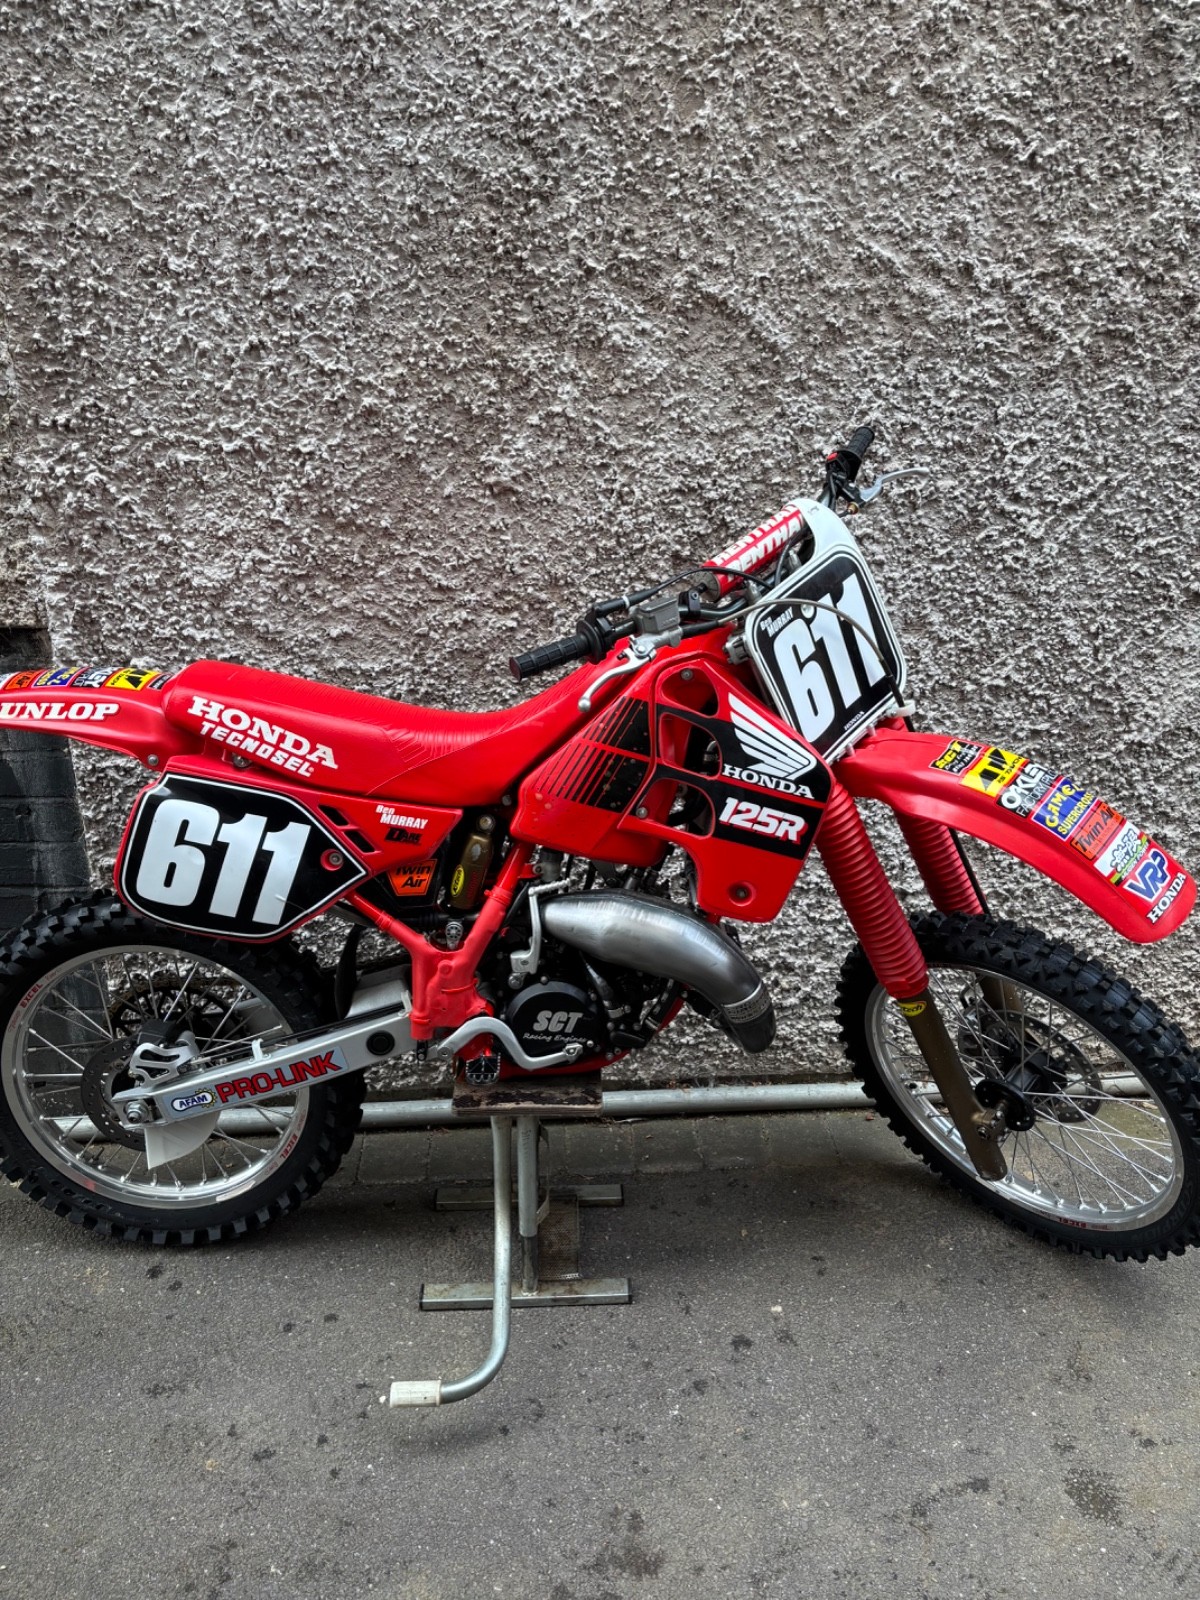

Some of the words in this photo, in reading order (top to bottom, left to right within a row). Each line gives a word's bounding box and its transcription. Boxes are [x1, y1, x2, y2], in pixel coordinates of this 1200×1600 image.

[767, 607, 794, 637] MURRAY
[773, 572, 886, 743] 611
[187, 695, 338, 769] HONDA
[200, 721, 312, 777] TECNOSEL
[722, 764, 815, 799] HONDA
[376, 805, 395, 815] Ben
[380, 814, 428, 829] MURRAY
[719, 797, 807, 843] 125R
[136, 799, 311, 925] 611
[401, 876, 427, 888] Air
[1123, 848, 1171, 902] VRP
[1146, 872, 1187, 923] HONDA
[533, 1010, 583, 1033] SCT
[215, 1050, 343, 1103] PRO-LINK
[179, 1093, 207, 1108] AFAM
